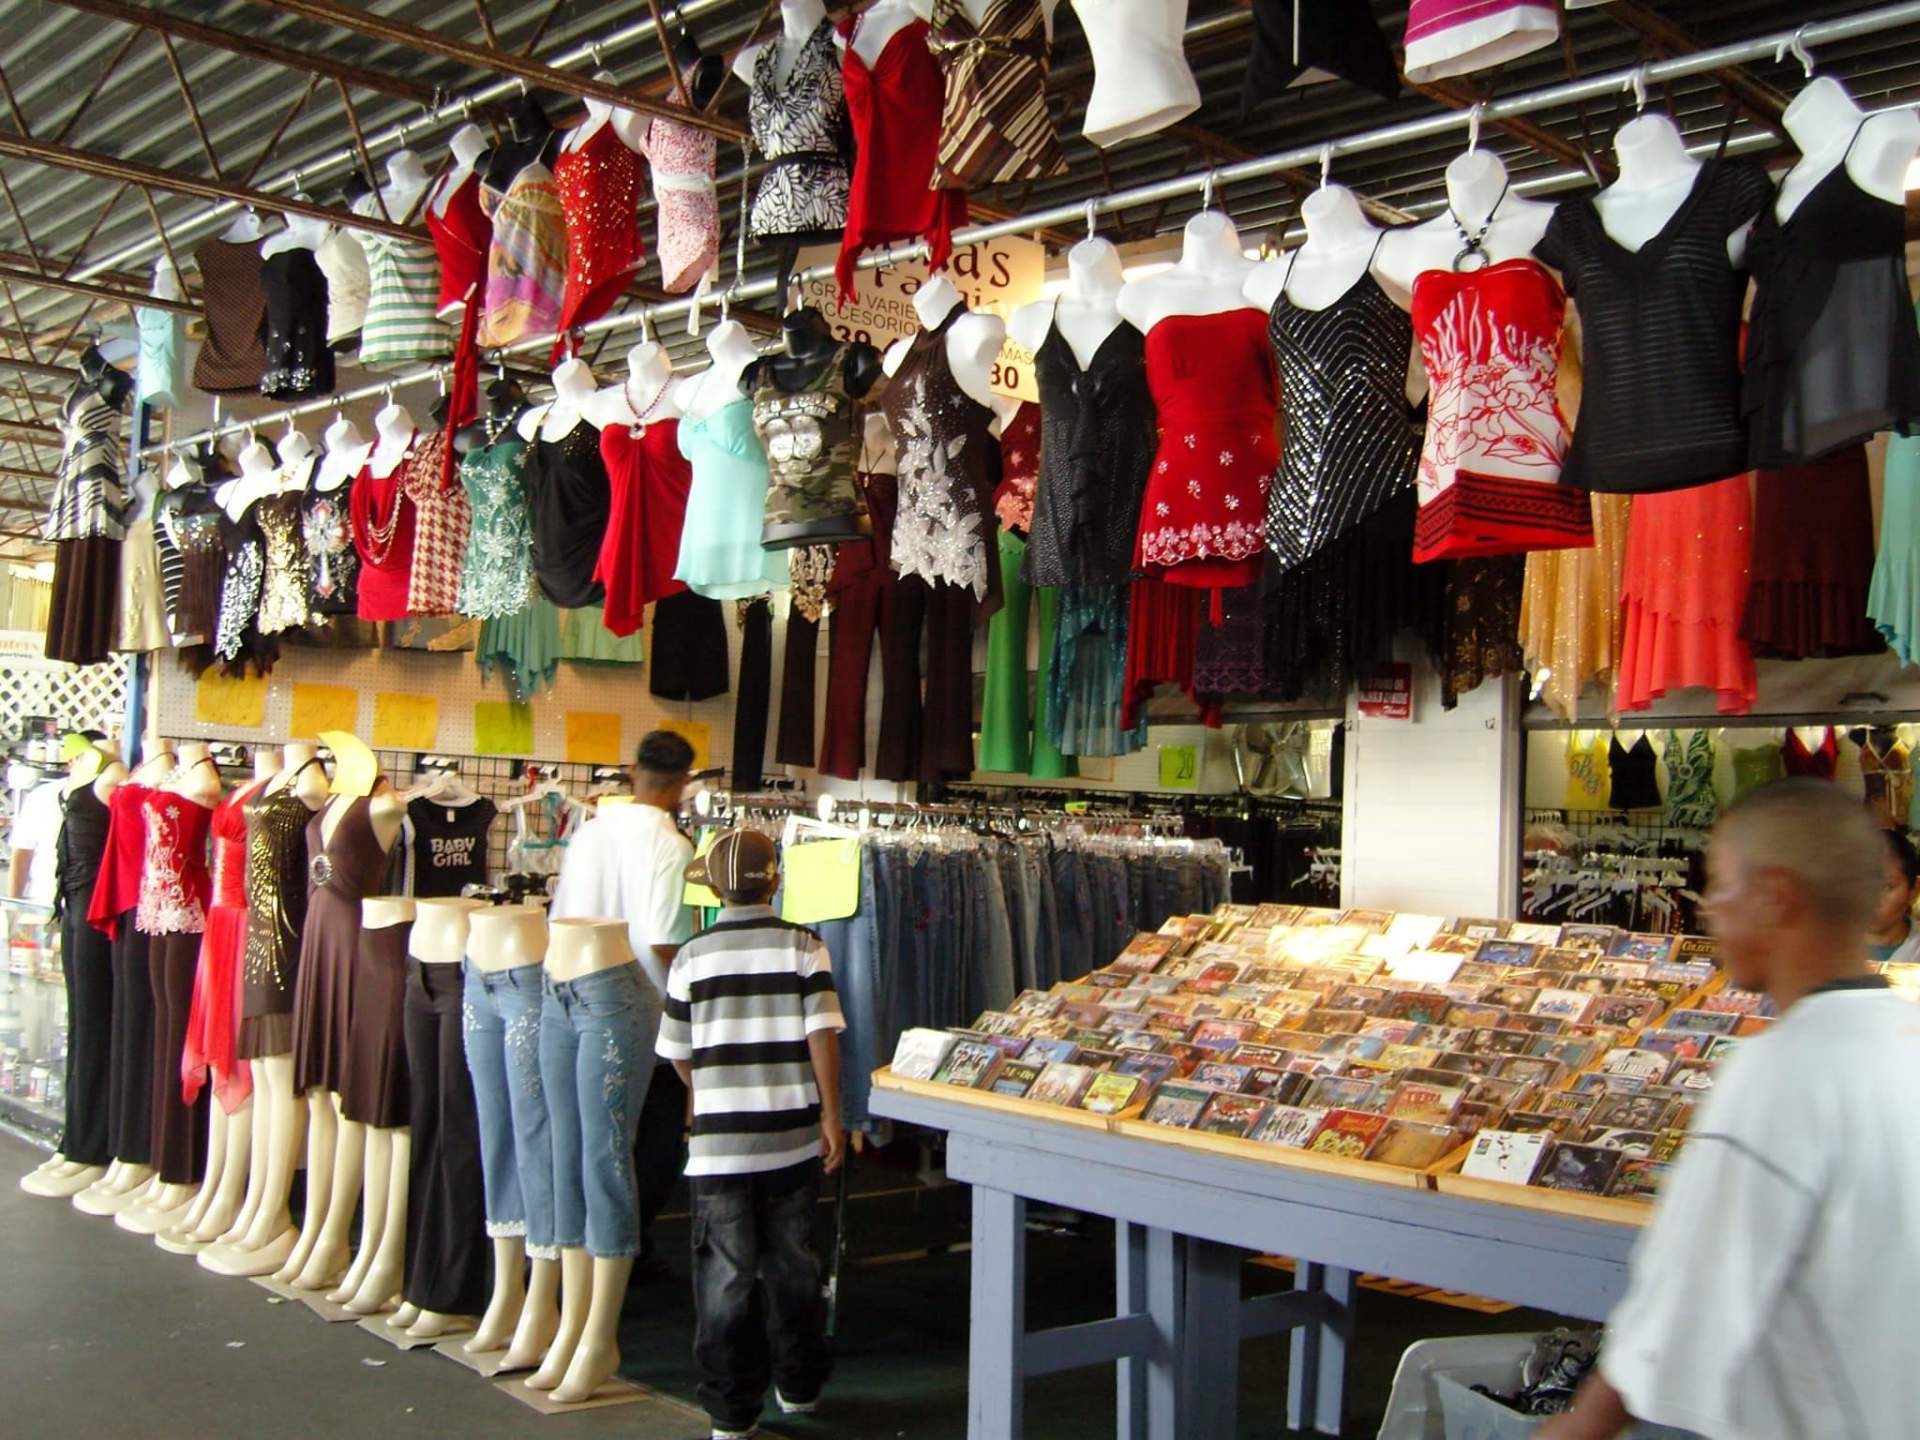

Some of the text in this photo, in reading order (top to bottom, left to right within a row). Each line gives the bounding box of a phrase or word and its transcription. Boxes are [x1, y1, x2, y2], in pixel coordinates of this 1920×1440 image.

[811, 280, 861, 305] GRN
[866, 293, 918, 320] VARIE
[430, 836, 476, 853] BABY
[433, 851, 472, 867] GIRL
